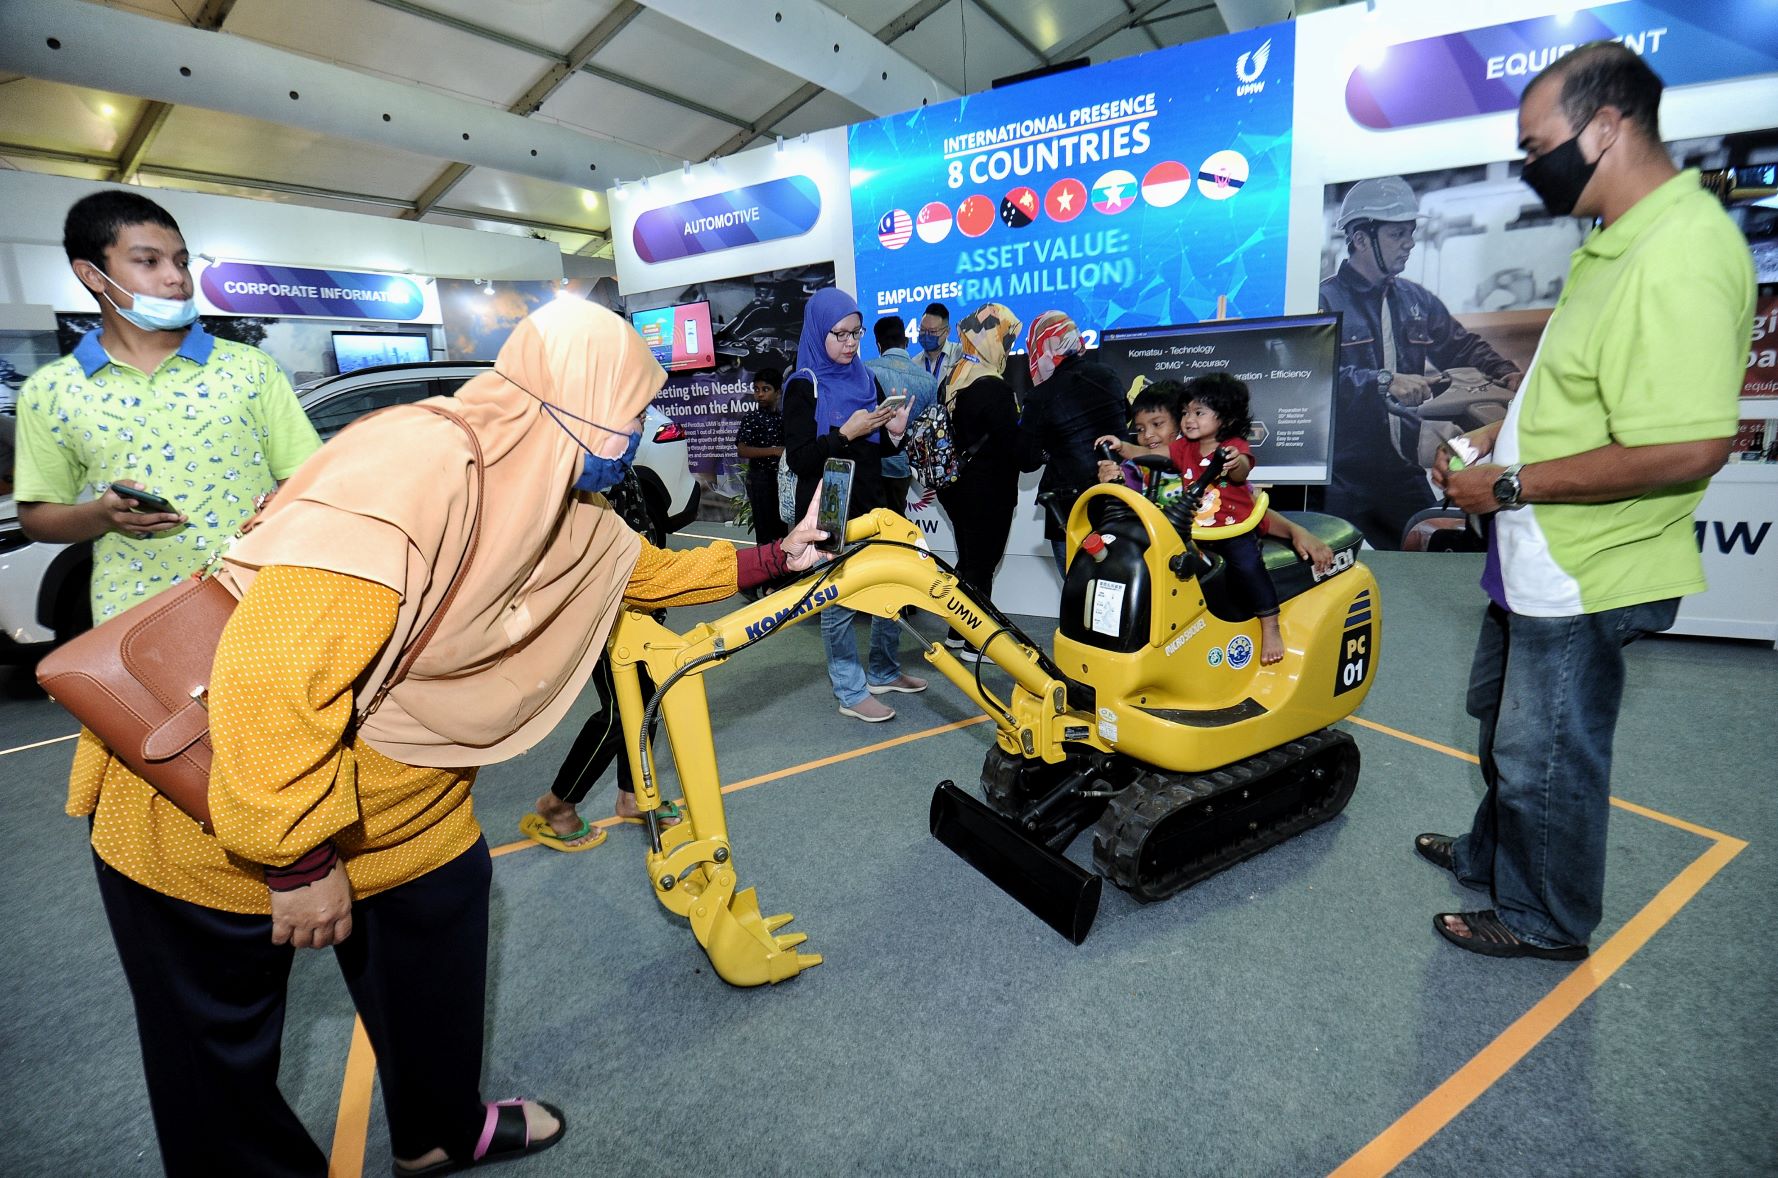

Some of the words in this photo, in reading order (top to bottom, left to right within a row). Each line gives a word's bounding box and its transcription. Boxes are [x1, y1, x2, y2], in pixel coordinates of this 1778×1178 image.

[1237, 81, 1265, 97] UMW
[944, 112, 1066, 154] INTERNATIONAL
[1070, 92, 1156, 126] PRESENCE
[948, 160, 964, 189] 8
[969, 121, 1151, 183] COUNTRIES
[684, 207, 760, 236] AUTOMOTIVE
[956, 241, 1030, 274] ASSET
[1034, 228, 1129, 264] VALUE:
[224, 281, 318, 298] CORPORATE
[877, 281, 963, 306] EMPLOYEES:
[957, 277, 1003, 307] (RM
[1009, 257, 1136, 296] MILLION)
[1129, 349, 1163, 357] Komatsu
[1170, 345, 1215, 355] Technology
[1191, 360, 1230, 369] Accuracy
[1271, 369, 1312, 379] Efficiency
[655, 385, 689, 401] eeting
[691, 383, 709, 397] the
[712, 379, 747, 396] Needs
[694, 406, 708, 415] on
[709, 401, 728, 414] the
[947, 596, 983, 630] UMW
[1347, 635, 1366, 659] PC
[1343, 659, 1363, 686] 01
